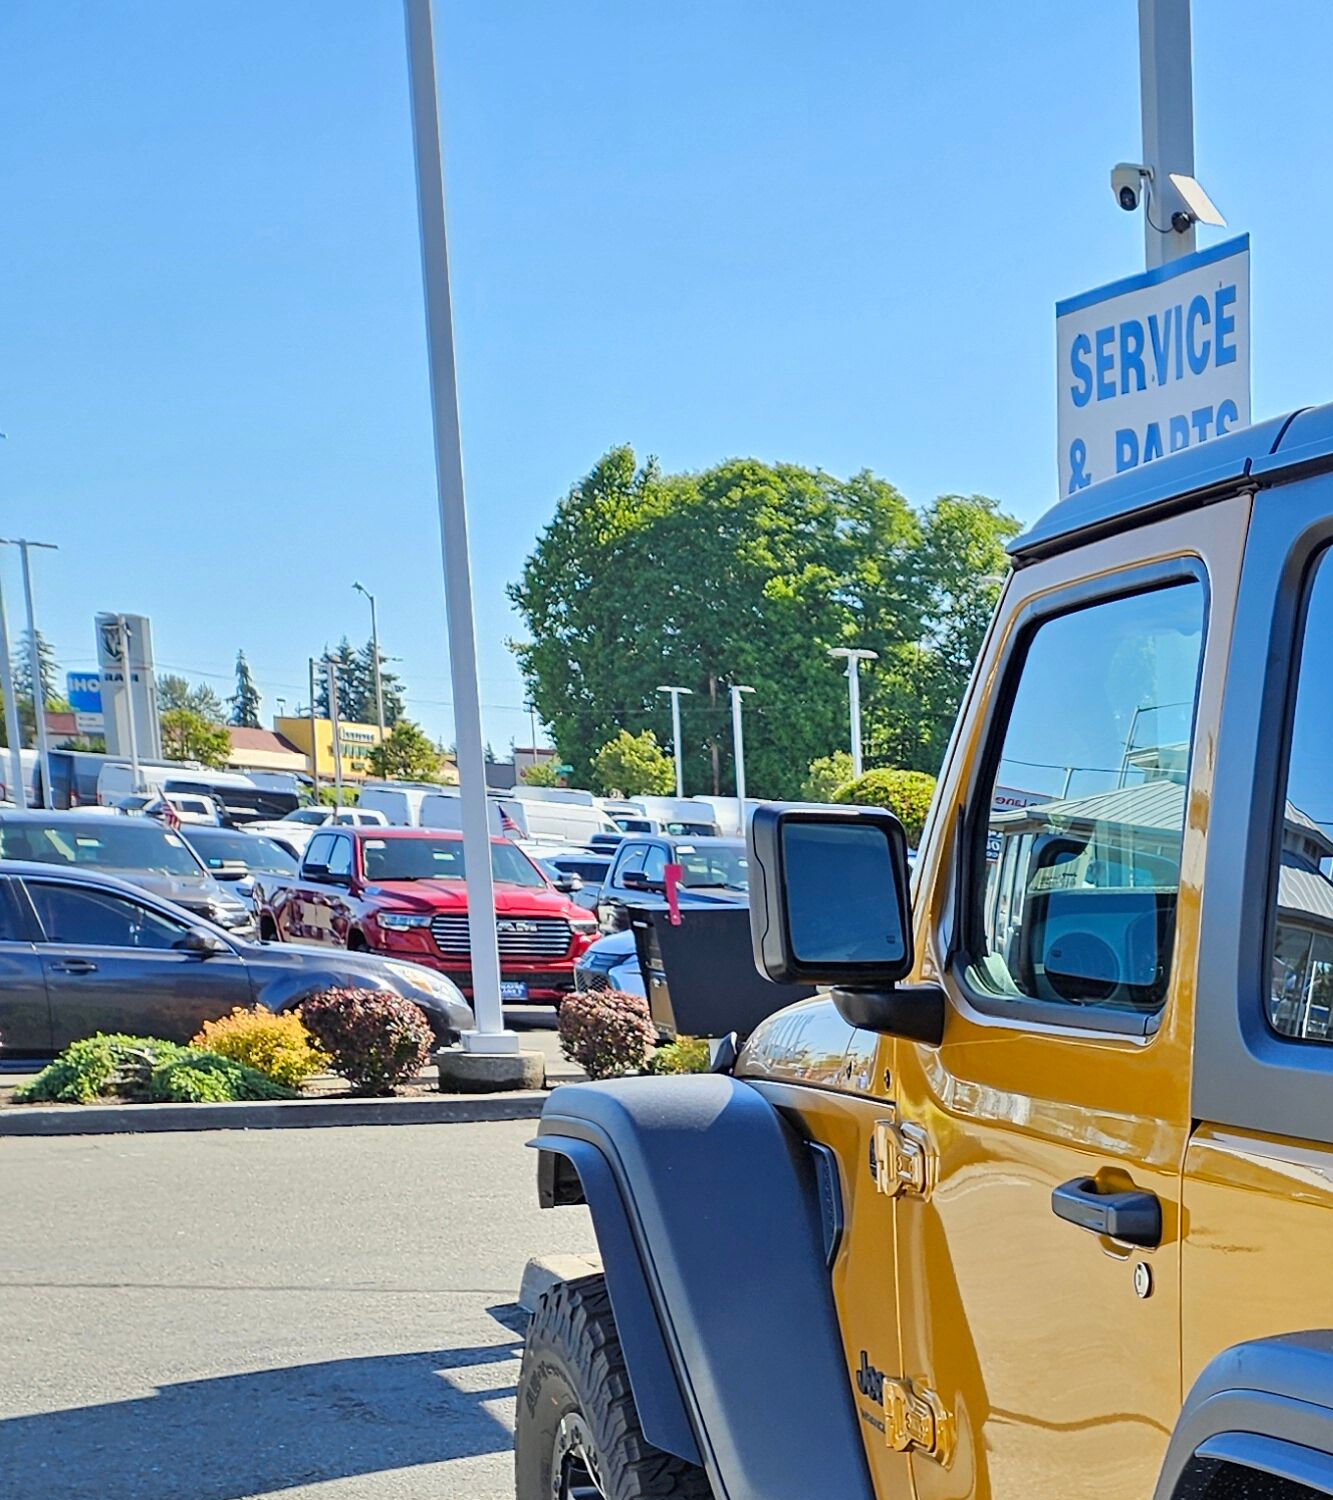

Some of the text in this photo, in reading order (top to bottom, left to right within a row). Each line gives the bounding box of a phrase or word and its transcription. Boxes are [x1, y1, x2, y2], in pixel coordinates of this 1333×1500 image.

[1070, 284, 1238, 408] SERVICE
[1069, 438, 1091, 493] &
[68, 677, 100, 693] IHO
